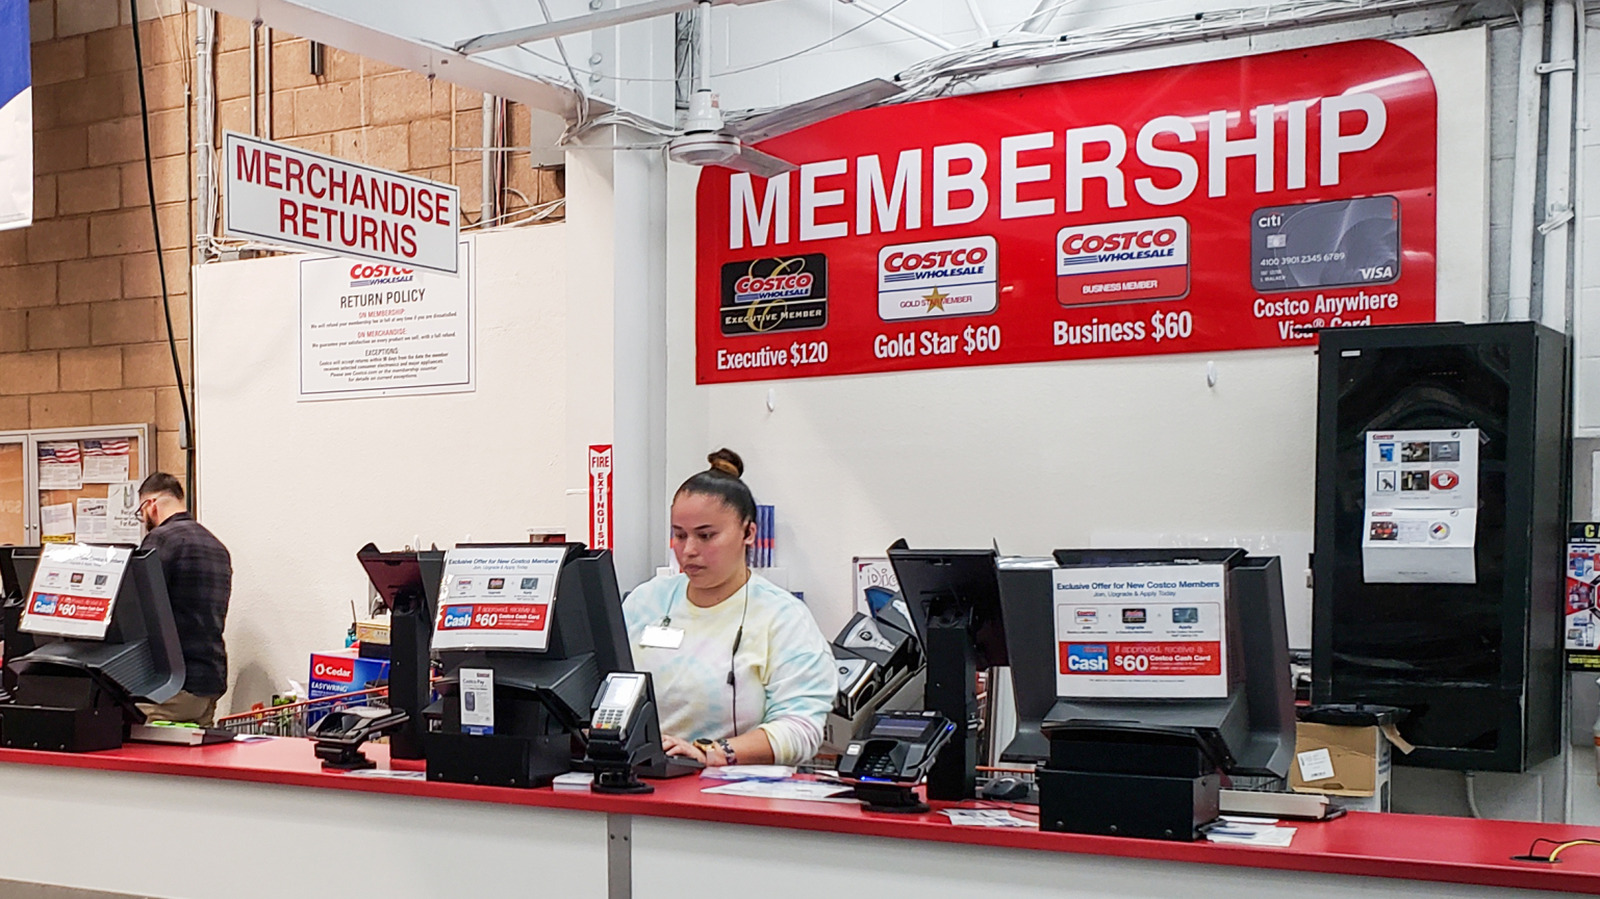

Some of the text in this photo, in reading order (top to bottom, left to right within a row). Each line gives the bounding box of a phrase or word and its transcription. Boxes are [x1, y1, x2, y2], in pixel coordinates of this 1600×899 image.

[729, 93, 1387, 249] MEMBERSHIP
[236, 145, 450, 226] MERCHANDISE
[279, 198, 417, 258] RETURNS
[1062, 228, 1177, 255] COSTCO
[884, 247, 988, 272] COSTCO
[1098, 248, 1174, 263] WHOLESALE
[1260, 252, 1345, 266] 4100 3901 2345 6789
[370, 275, 414, 286] WHOLESALE
[914, 265, 985, 280] WHOLESALE
[1361, 266, 1393, 280] VISA
[734, 273, 813, 294] COSTCO
[1082, 280, 1158, 294] BUSINESS MEMBER
[340, 288, 426, 308] RETURN POLICY
[758, 288, 809, 299] WHOLESALE
[899, 300, 920, 308] GOLD
[1253, 291, 1399, 318] Costco Anywhere
[1053, 310, 1192, 345] Business $60
[874, 325, 1000, 358] Gold Star $60
[717, 342, 829, 370] Executive $120
[591, 456, 610, 468] FIRE
[597, 472, 605, 550] EXTINGUISH
[1056, 582, 1090, 590] Exclusive
[1126, 581, 1144, 589] New
[1146, 581, 1177, 589] Costco
[1179, 580, 1220, 588] Members
[33, 600, 56, 614] Cash
[444, 614, 471, 628] Cash
[475, 613, 497, 627] $60
[1068, 655, 1108, 671] Cash
[1115, 655, 1148, 671] $60
